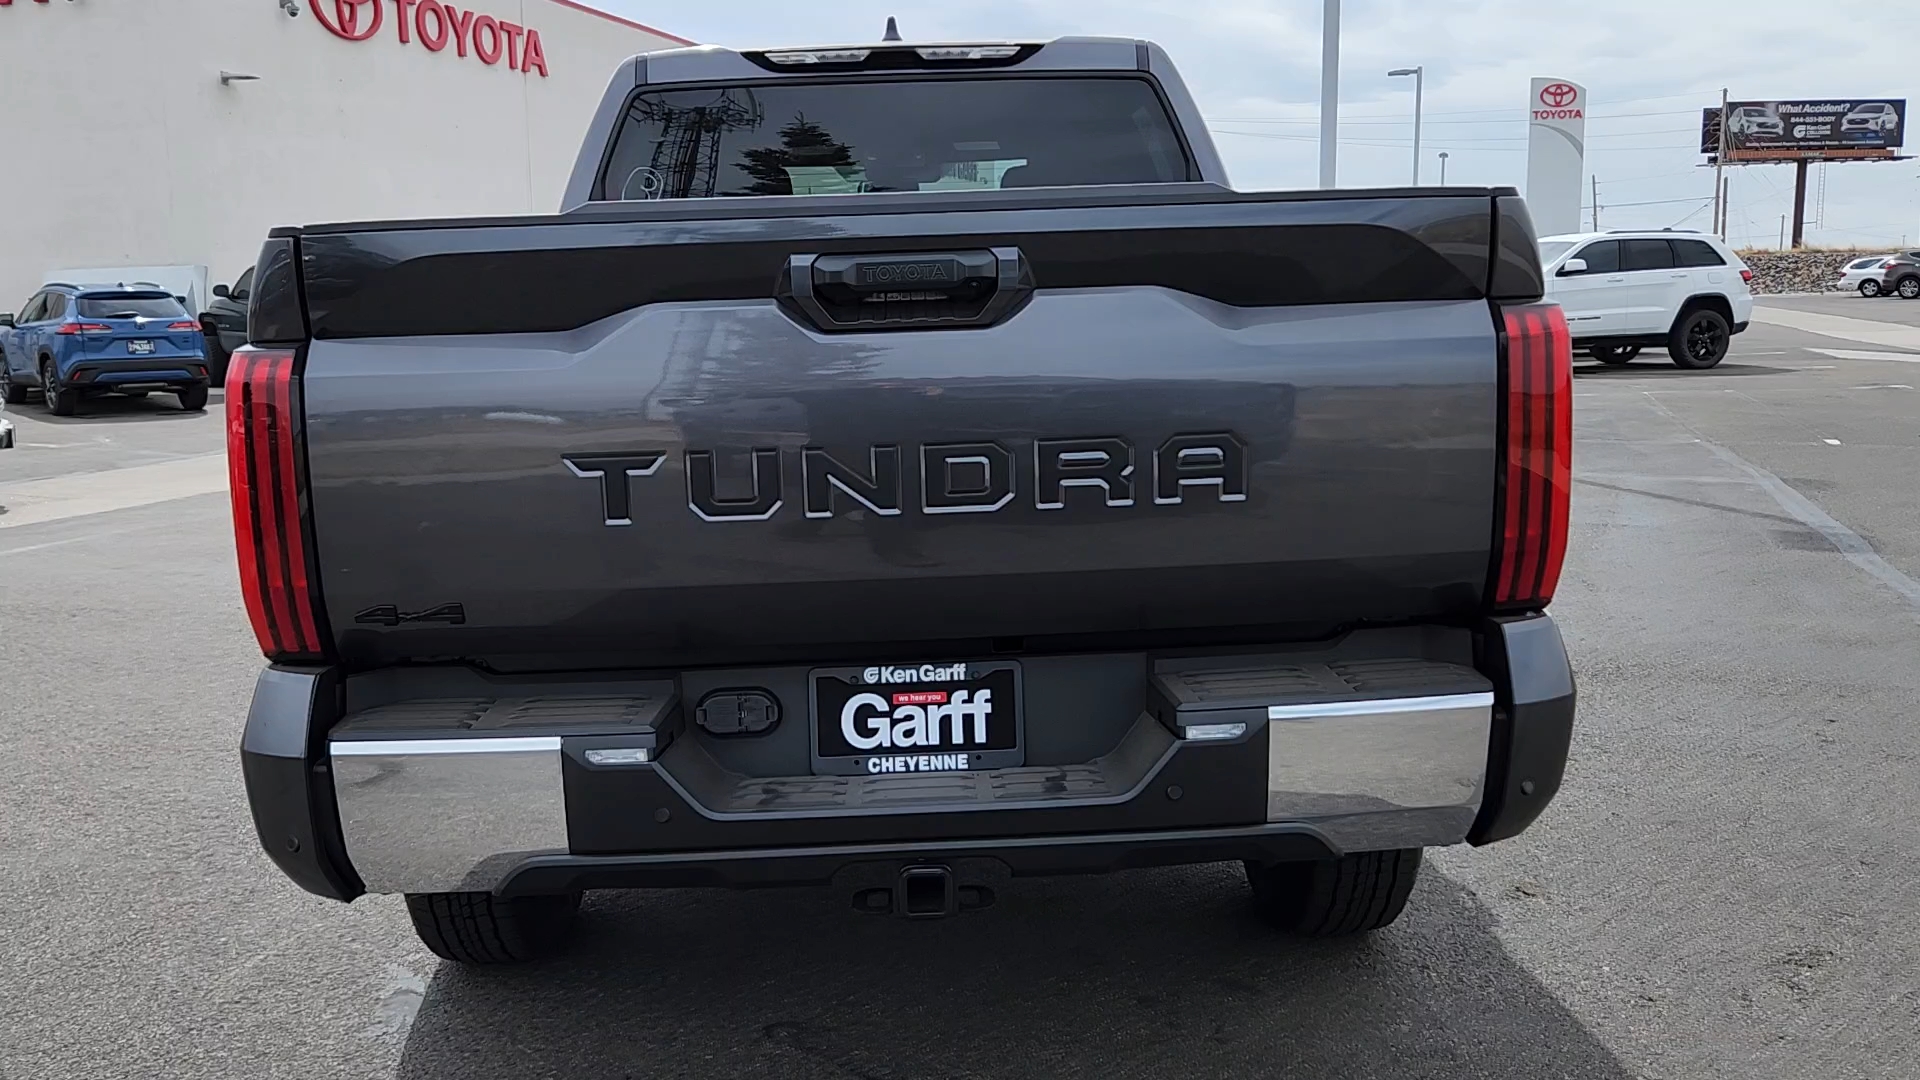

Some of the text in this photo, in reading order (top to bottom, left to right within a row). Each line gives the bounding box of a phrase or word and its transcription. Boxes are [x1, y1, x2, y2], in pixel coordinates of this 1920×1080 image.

[389, 0, 548, 77] TOYOTA
[1532, 109, 1583, 120] TOYOTA
[1778, 103, 1851, 113] What Accident?
[863, 263, 948, 283] TOYOTA
[560, 430, 1249, 527] TUNDRA
[880, 663, 967, 683] Ken Garff
[910, 694, 926, 702] hear
[927, 694, 941, 703] you
[841, 689, 992, 749] Garff
[867, 754, 969, 774] CHEYENNE
